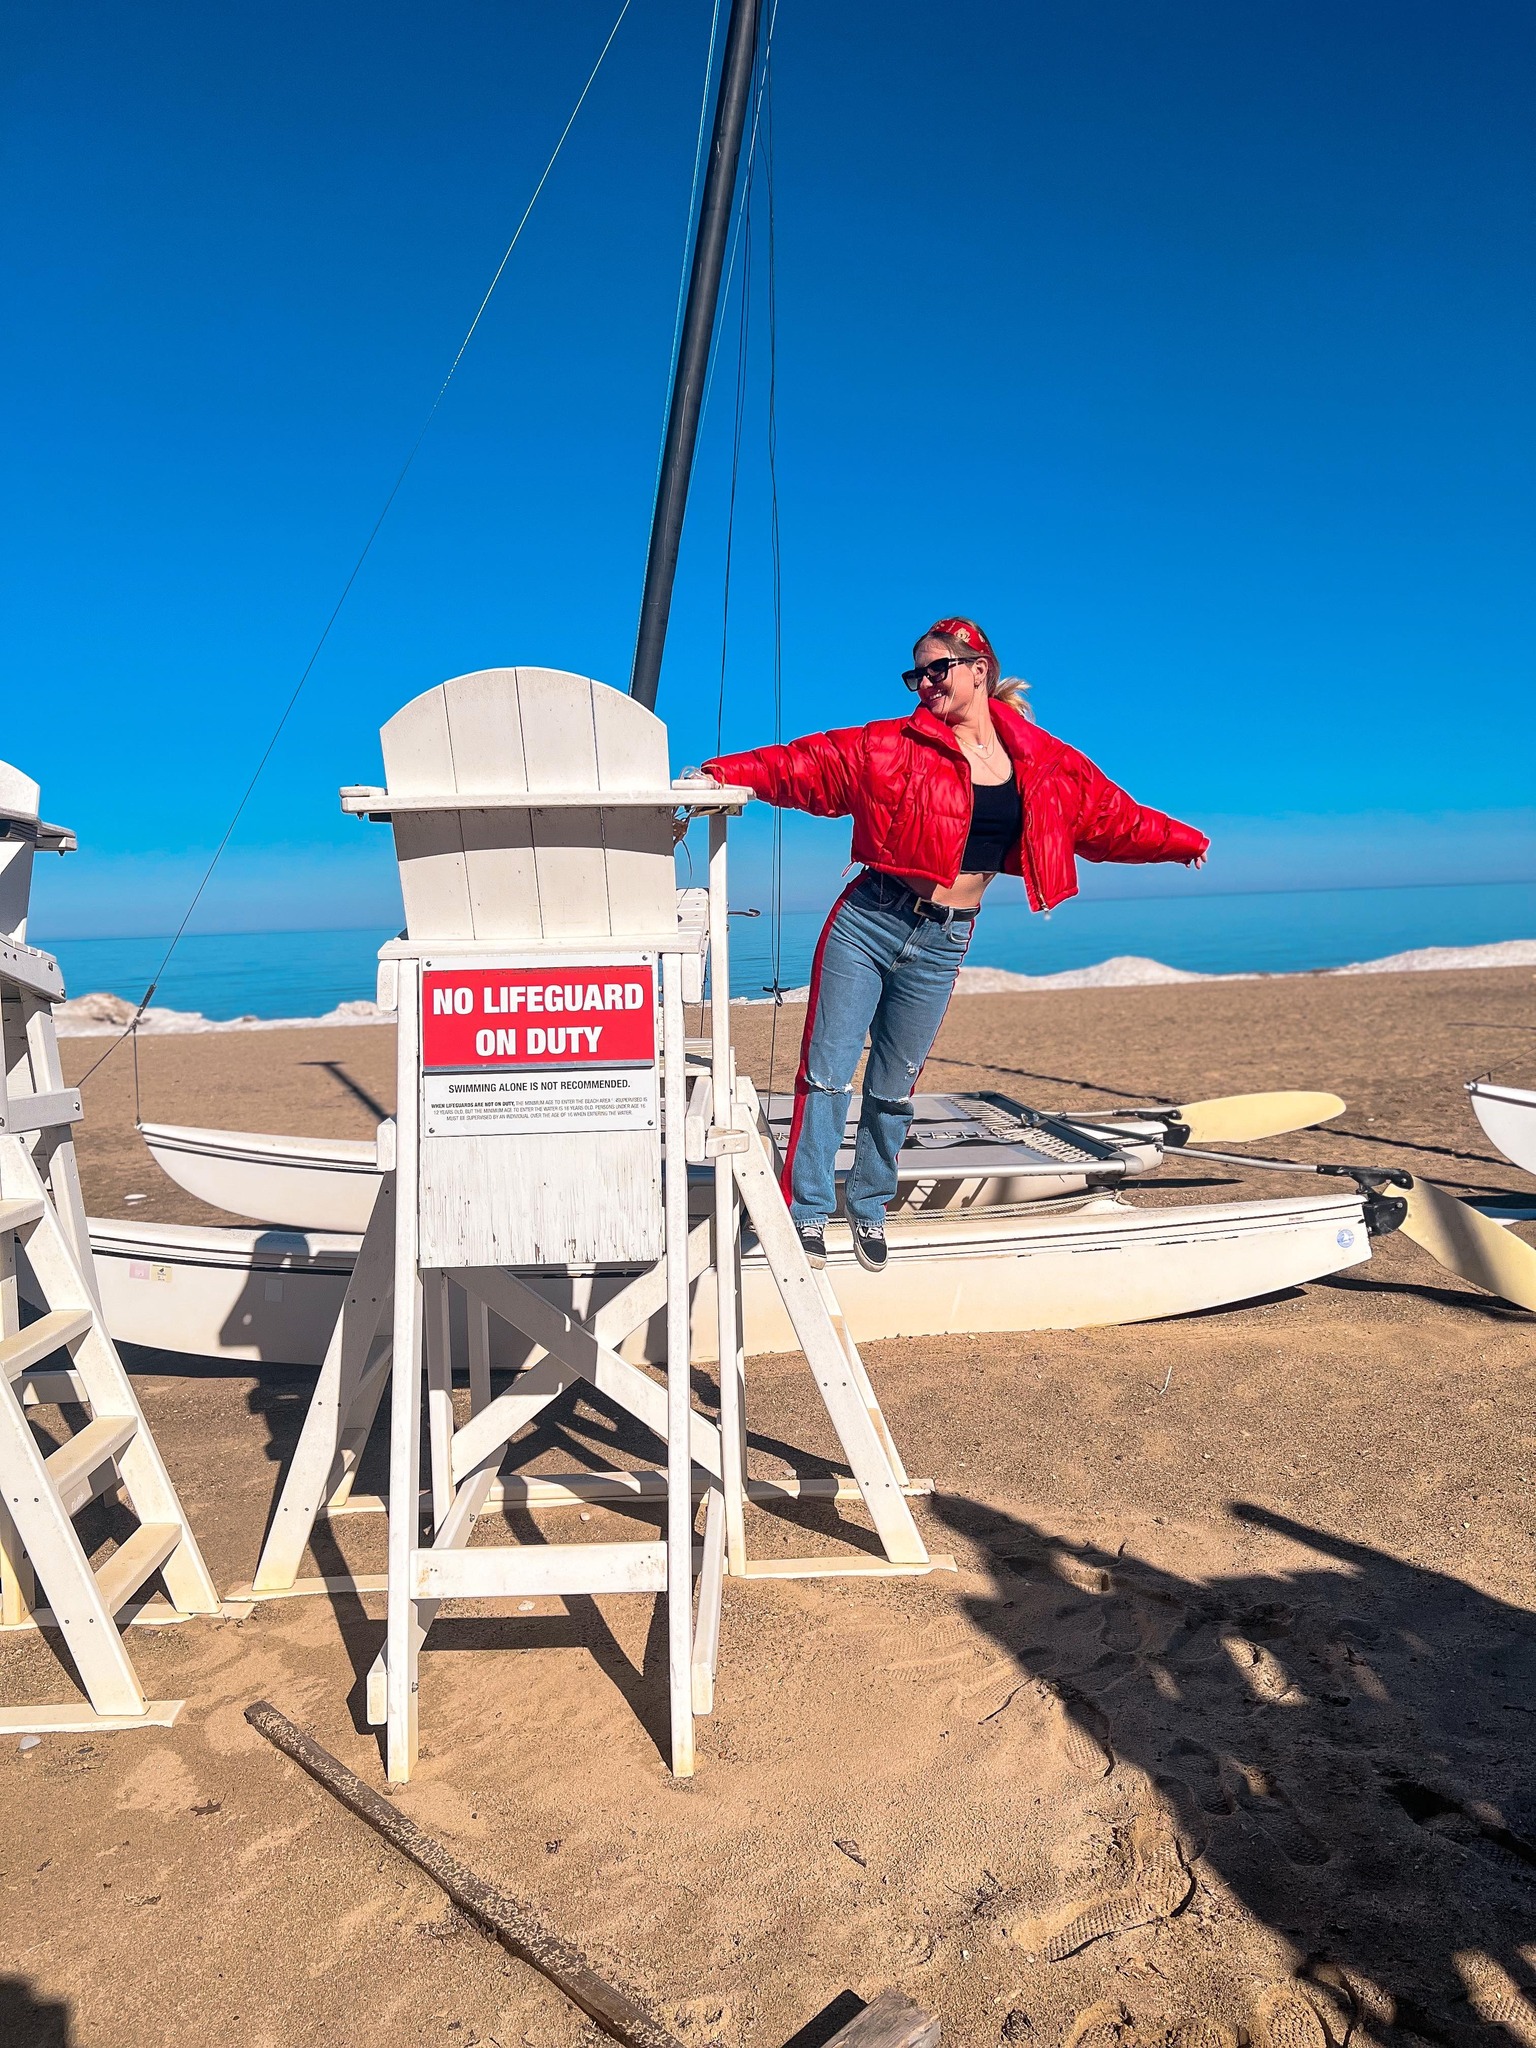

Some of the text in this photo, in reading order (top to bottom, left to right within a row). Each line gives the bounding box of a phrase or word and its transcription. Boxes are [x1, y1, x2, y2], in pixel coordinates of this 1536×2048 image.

[433, 983, 644, 1015] NO LIFEGUARD
[475, 1026, 603, 1056] ON DUTY
[448, 1079, 631, 1094] SWIMMING ALONE IS NOT RECOMMENDED.
